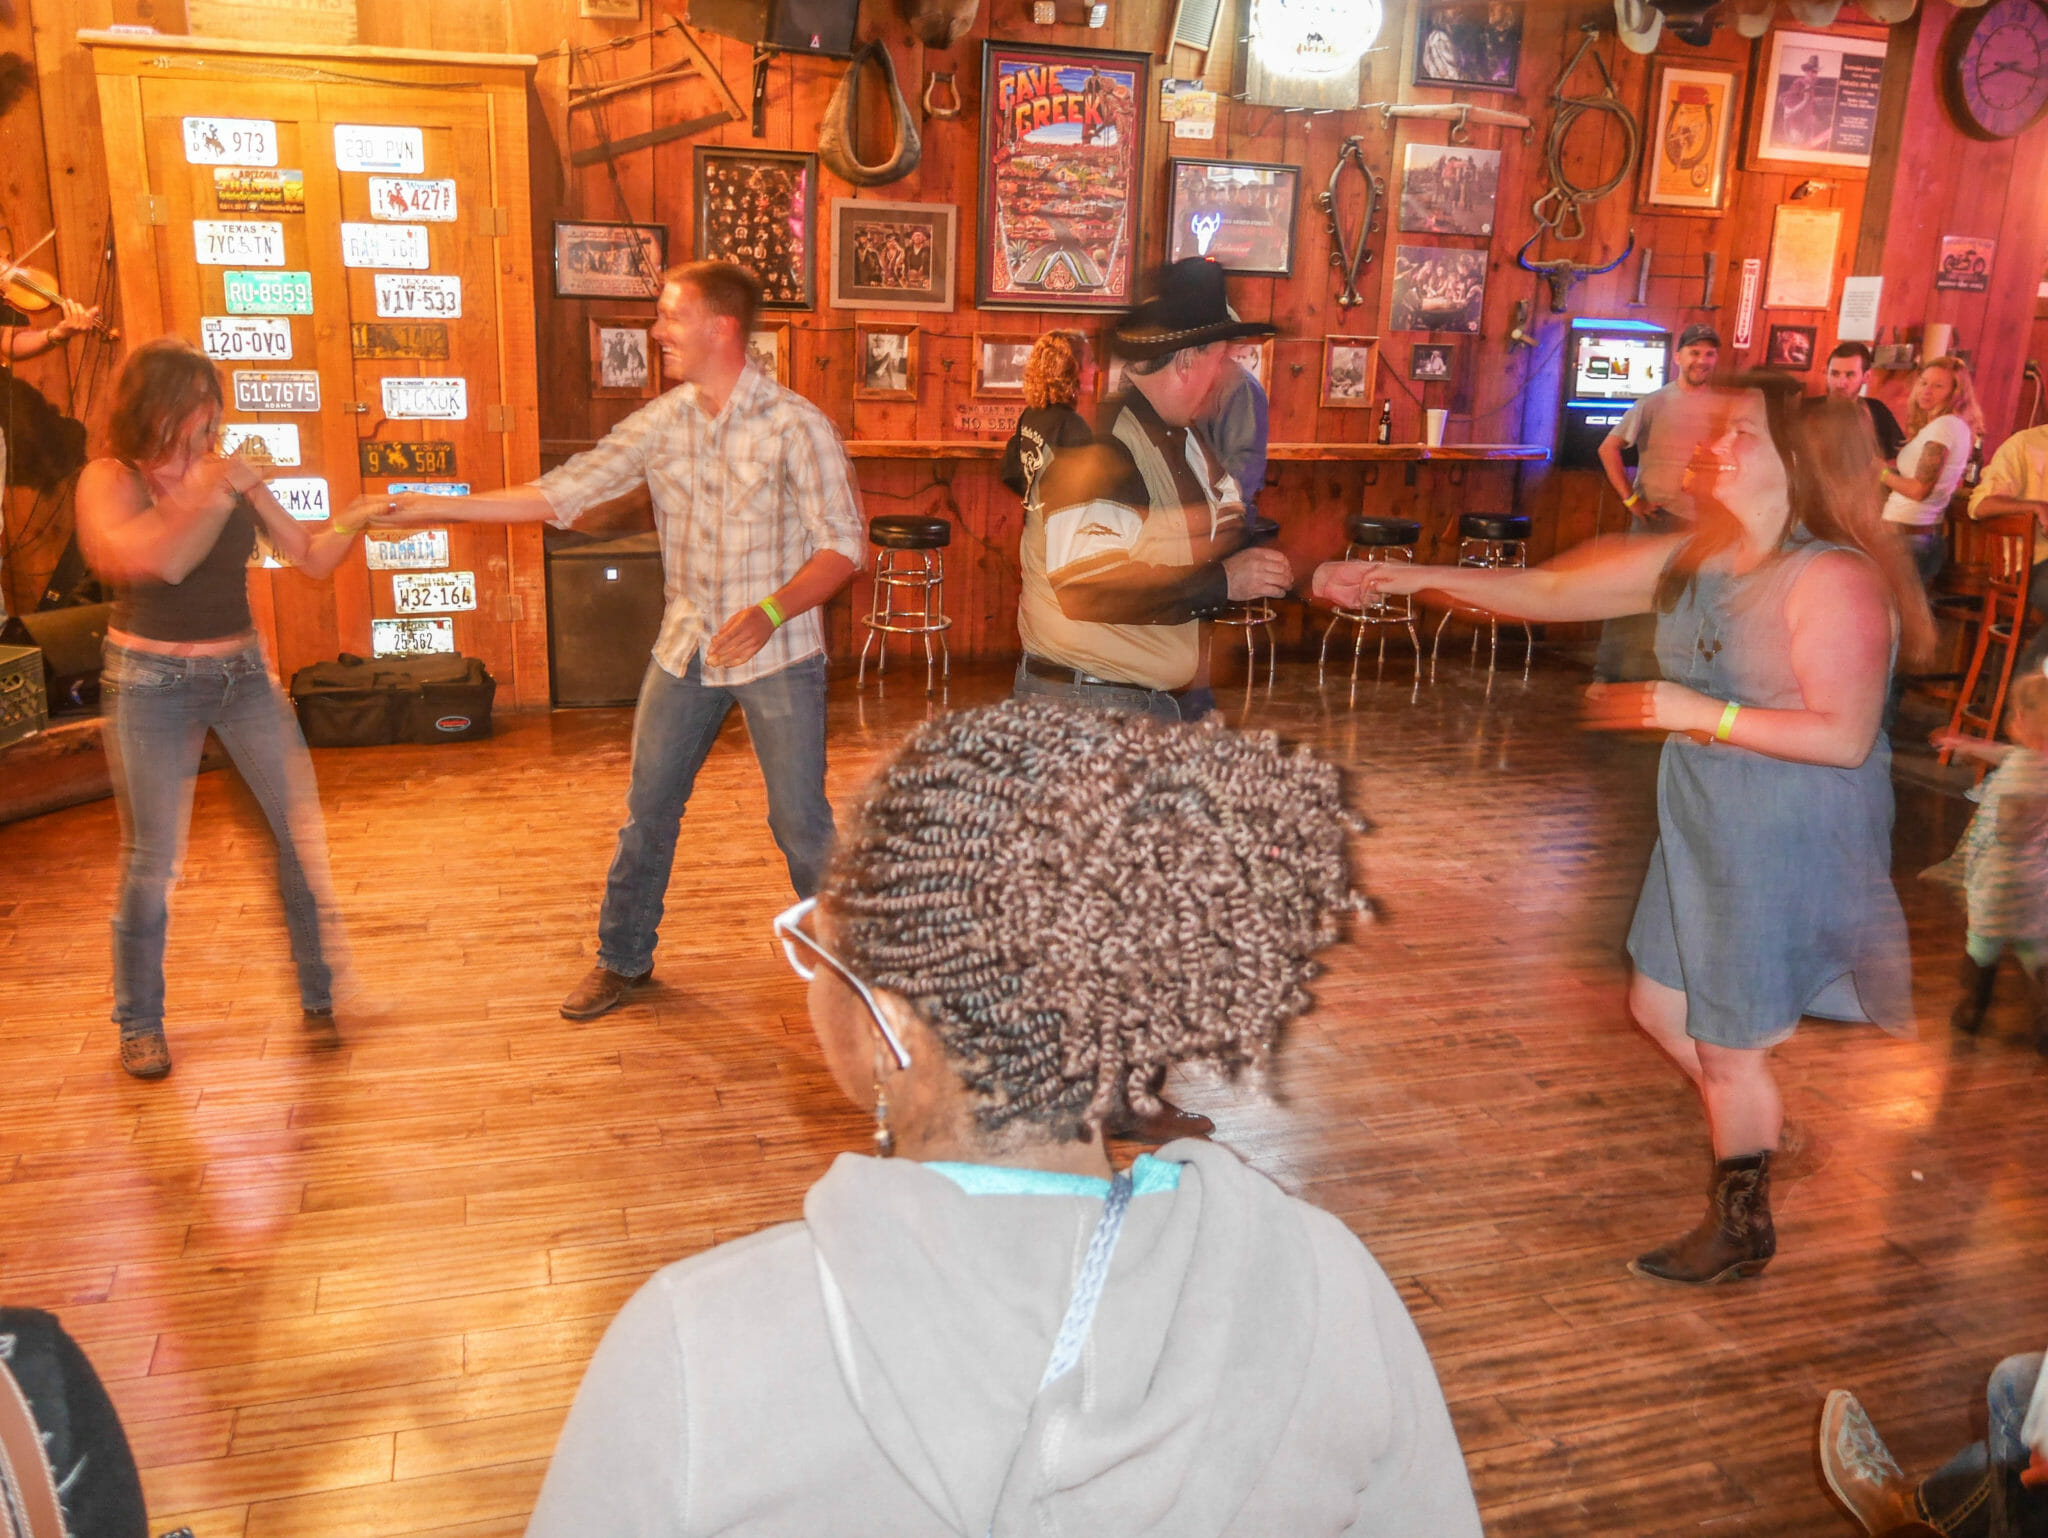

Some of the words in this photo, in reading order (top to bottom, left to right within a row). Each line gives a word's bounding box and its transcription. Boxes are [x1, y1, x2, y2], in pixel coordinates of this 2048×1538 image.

[999, 65, 1064, 111] CAVE
[1014, 92, 1104, 139] CREEK
[232, 131, 265, 153] 973
[411, 189, 440, 211] 427
[222, 225, 257, 234] TEXAS
[254, 236, 272, 255] TN
[230, 282, 307, 303] RU-8959
[382, 290, 456, 312] V1V-533
[240, 383, 316, 402] G1C7675
[961, 417, 982, 430] NO
[369, 451, 379, 473] 9
[415, 451, 446, 473] 584
